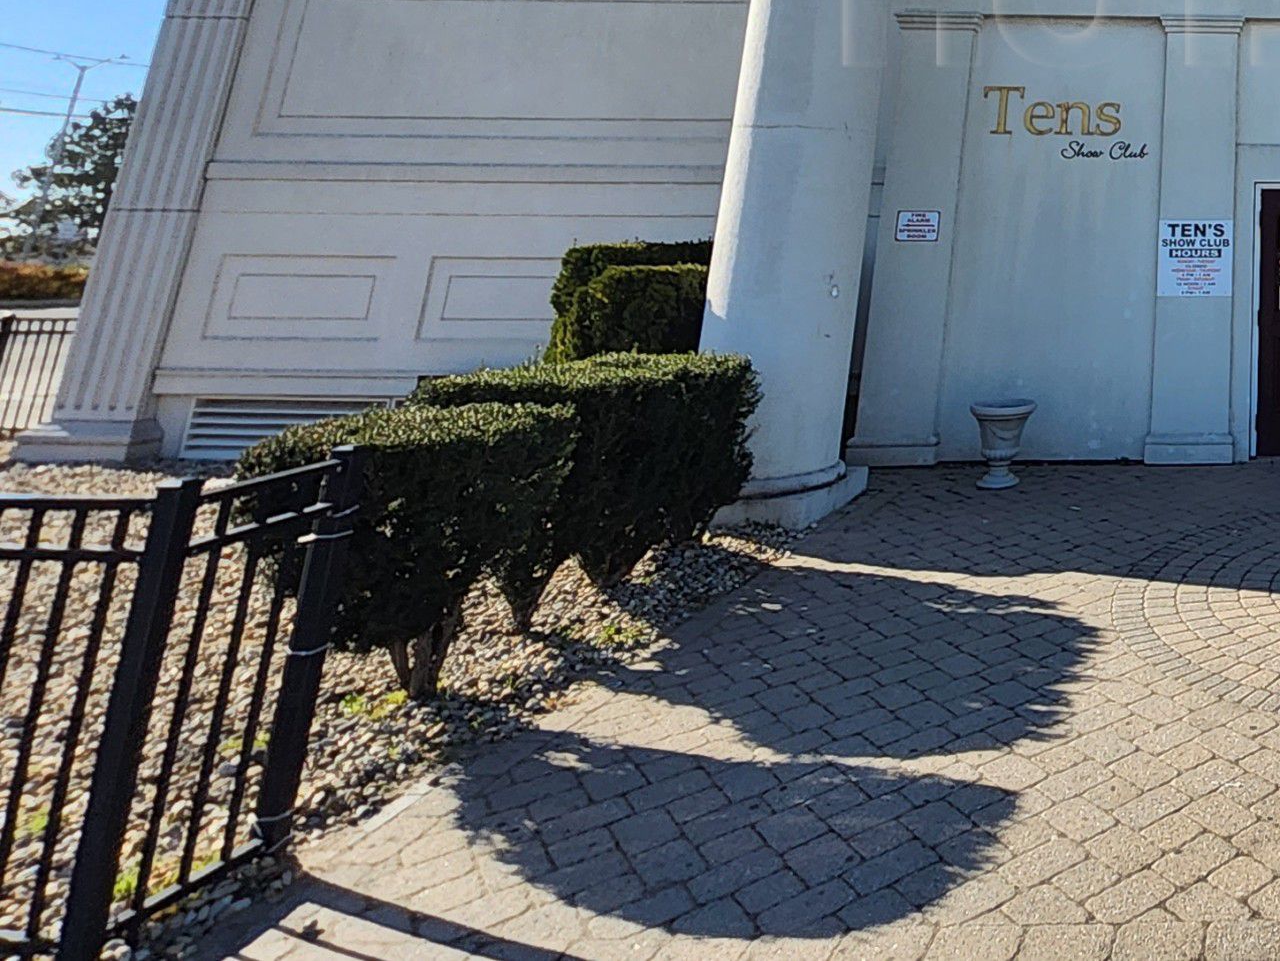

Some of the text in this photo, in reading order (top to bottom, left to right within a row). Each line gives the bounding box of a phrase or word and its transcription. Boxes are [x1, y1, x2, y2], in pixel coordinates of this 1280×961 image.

[984, 86, 1121, 136] Tens
[1060, 140, 1149, 160] Show Club
[1167, 223, 1225, 237] TEN'S
[1161, 239, 1230, 247] SHOW CLUB
[1171, 249, 1220, 257] HOURS
